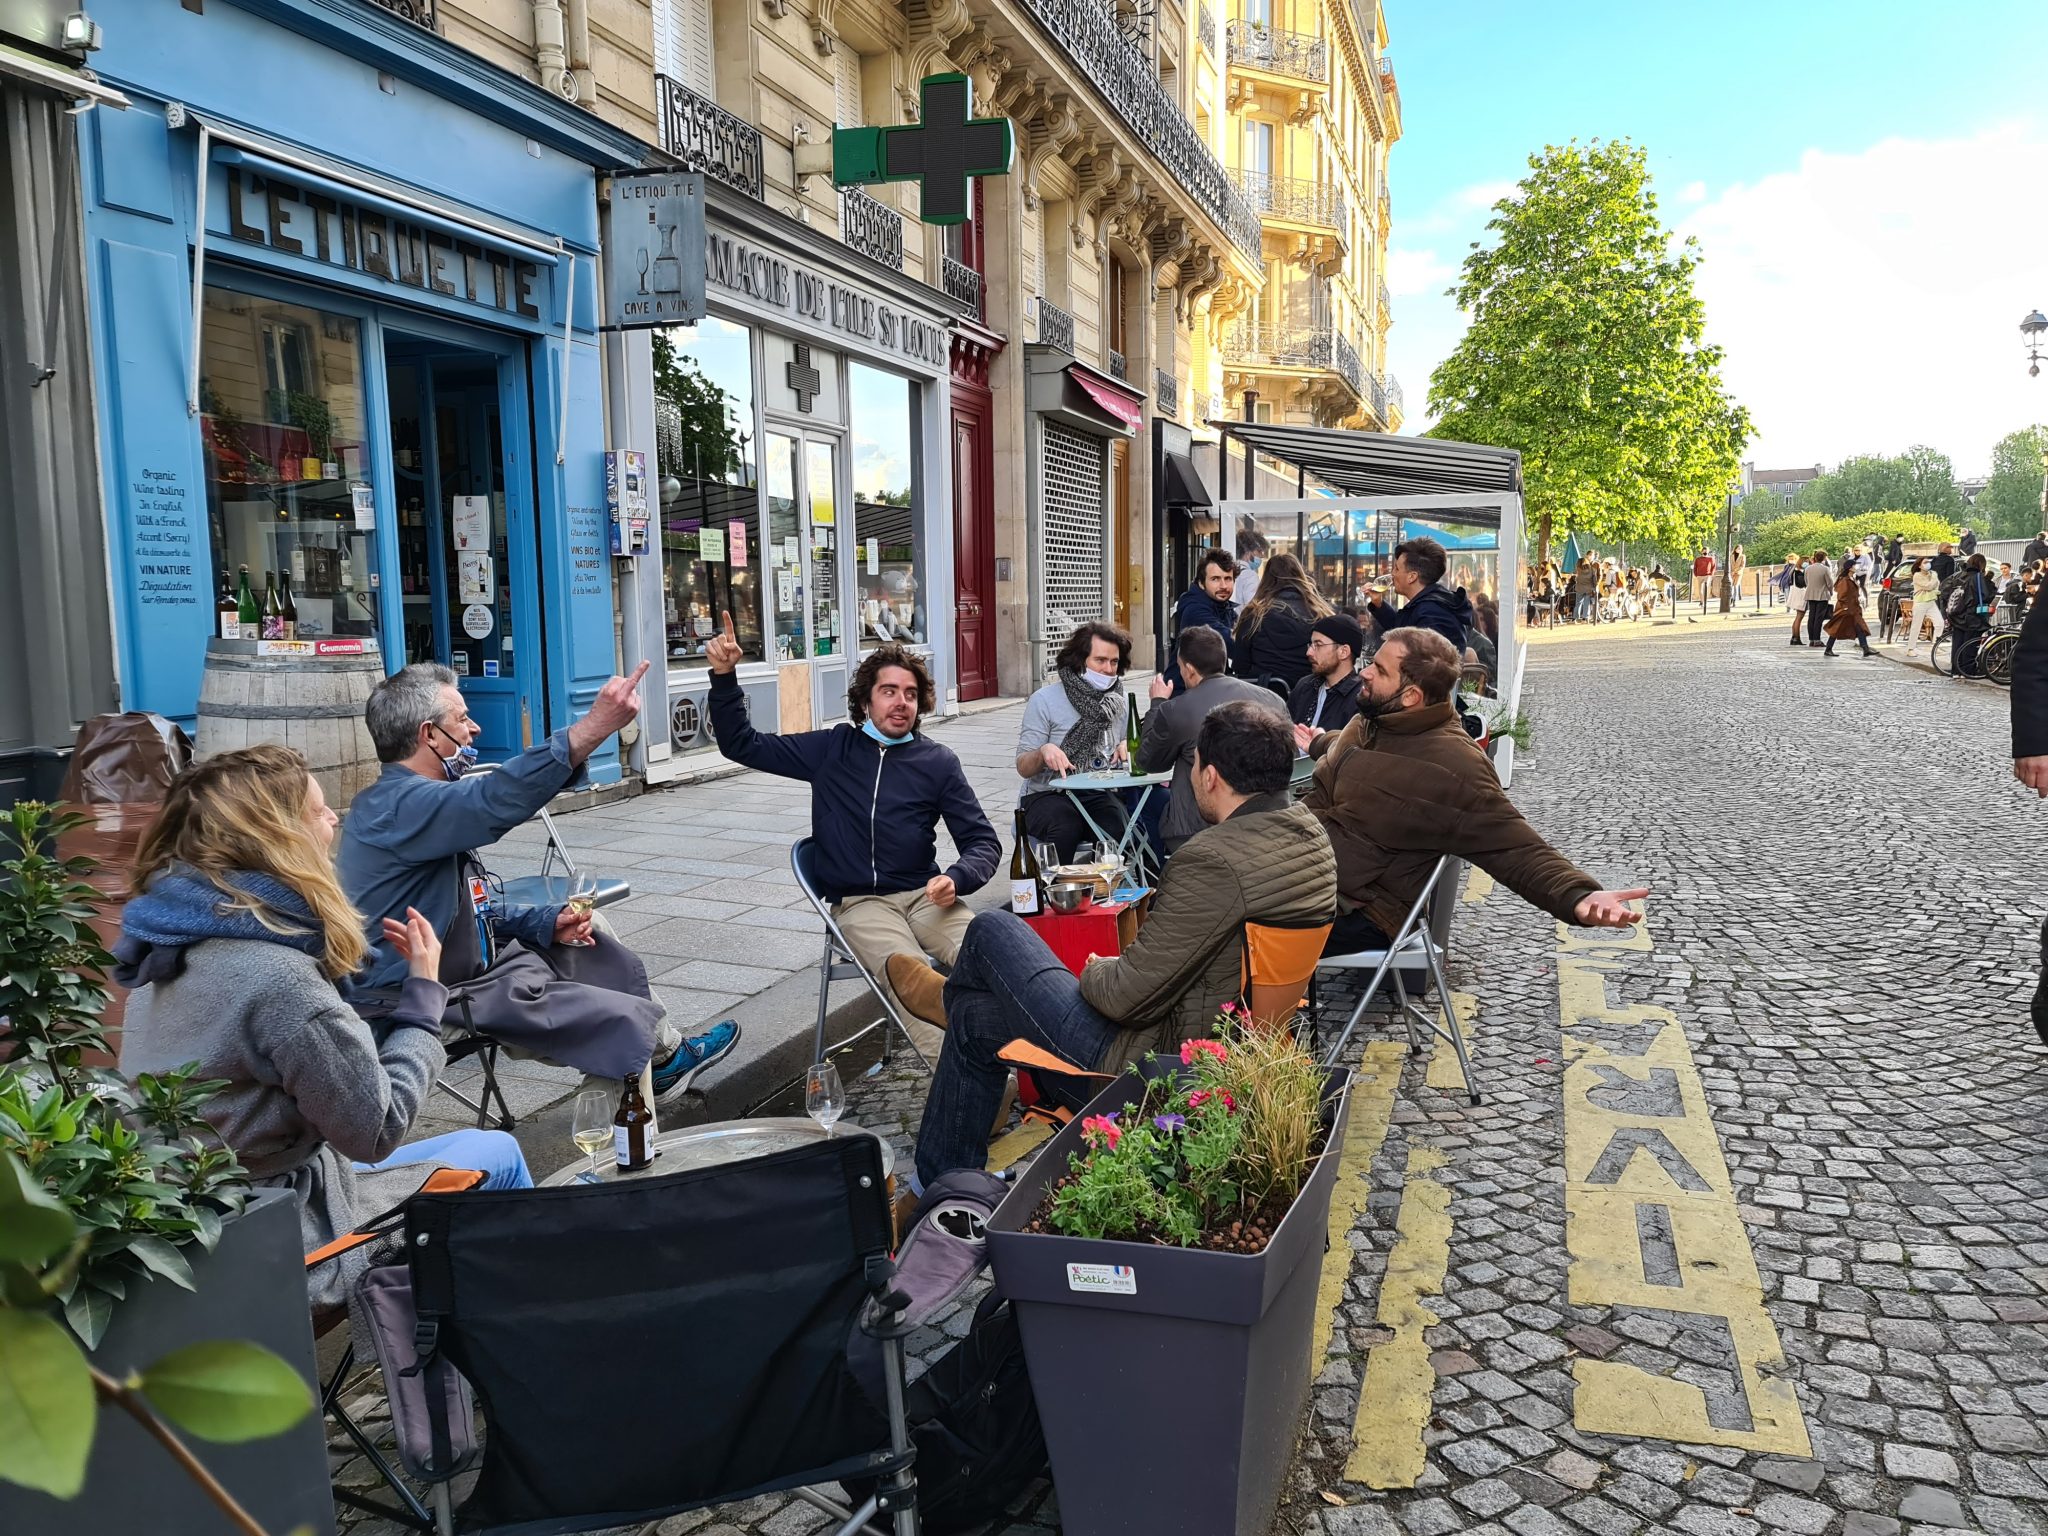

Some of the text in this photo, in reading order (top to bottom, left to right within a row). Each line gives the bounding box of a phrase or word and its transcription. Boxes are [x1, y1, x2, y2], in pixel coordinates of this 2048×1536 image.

[622, 184, 694, 200] L'ETIQUTE
[227, 164, 539, 321] L'ETIQUETTE
[624, 301, 650, 315] CAVE
[795, 269, 826, 322] DE
[901, 314, 946, 367] LOUIS
[142, 469, 176, 482] Organic
[133, 483, 185, 498] Wine tasting
[152, 500, 183, 514] English
[136, 515, 154, 526] With
[163, 532, 190, 544] (Sorry)
[571, 546, 601, 555] VINS BIO et
[140, 565, 192, 575] VIN NATURE
[575, 560, 600, 569] NATURES
[1562, 897, 1762, 1437] LIVRAISO
